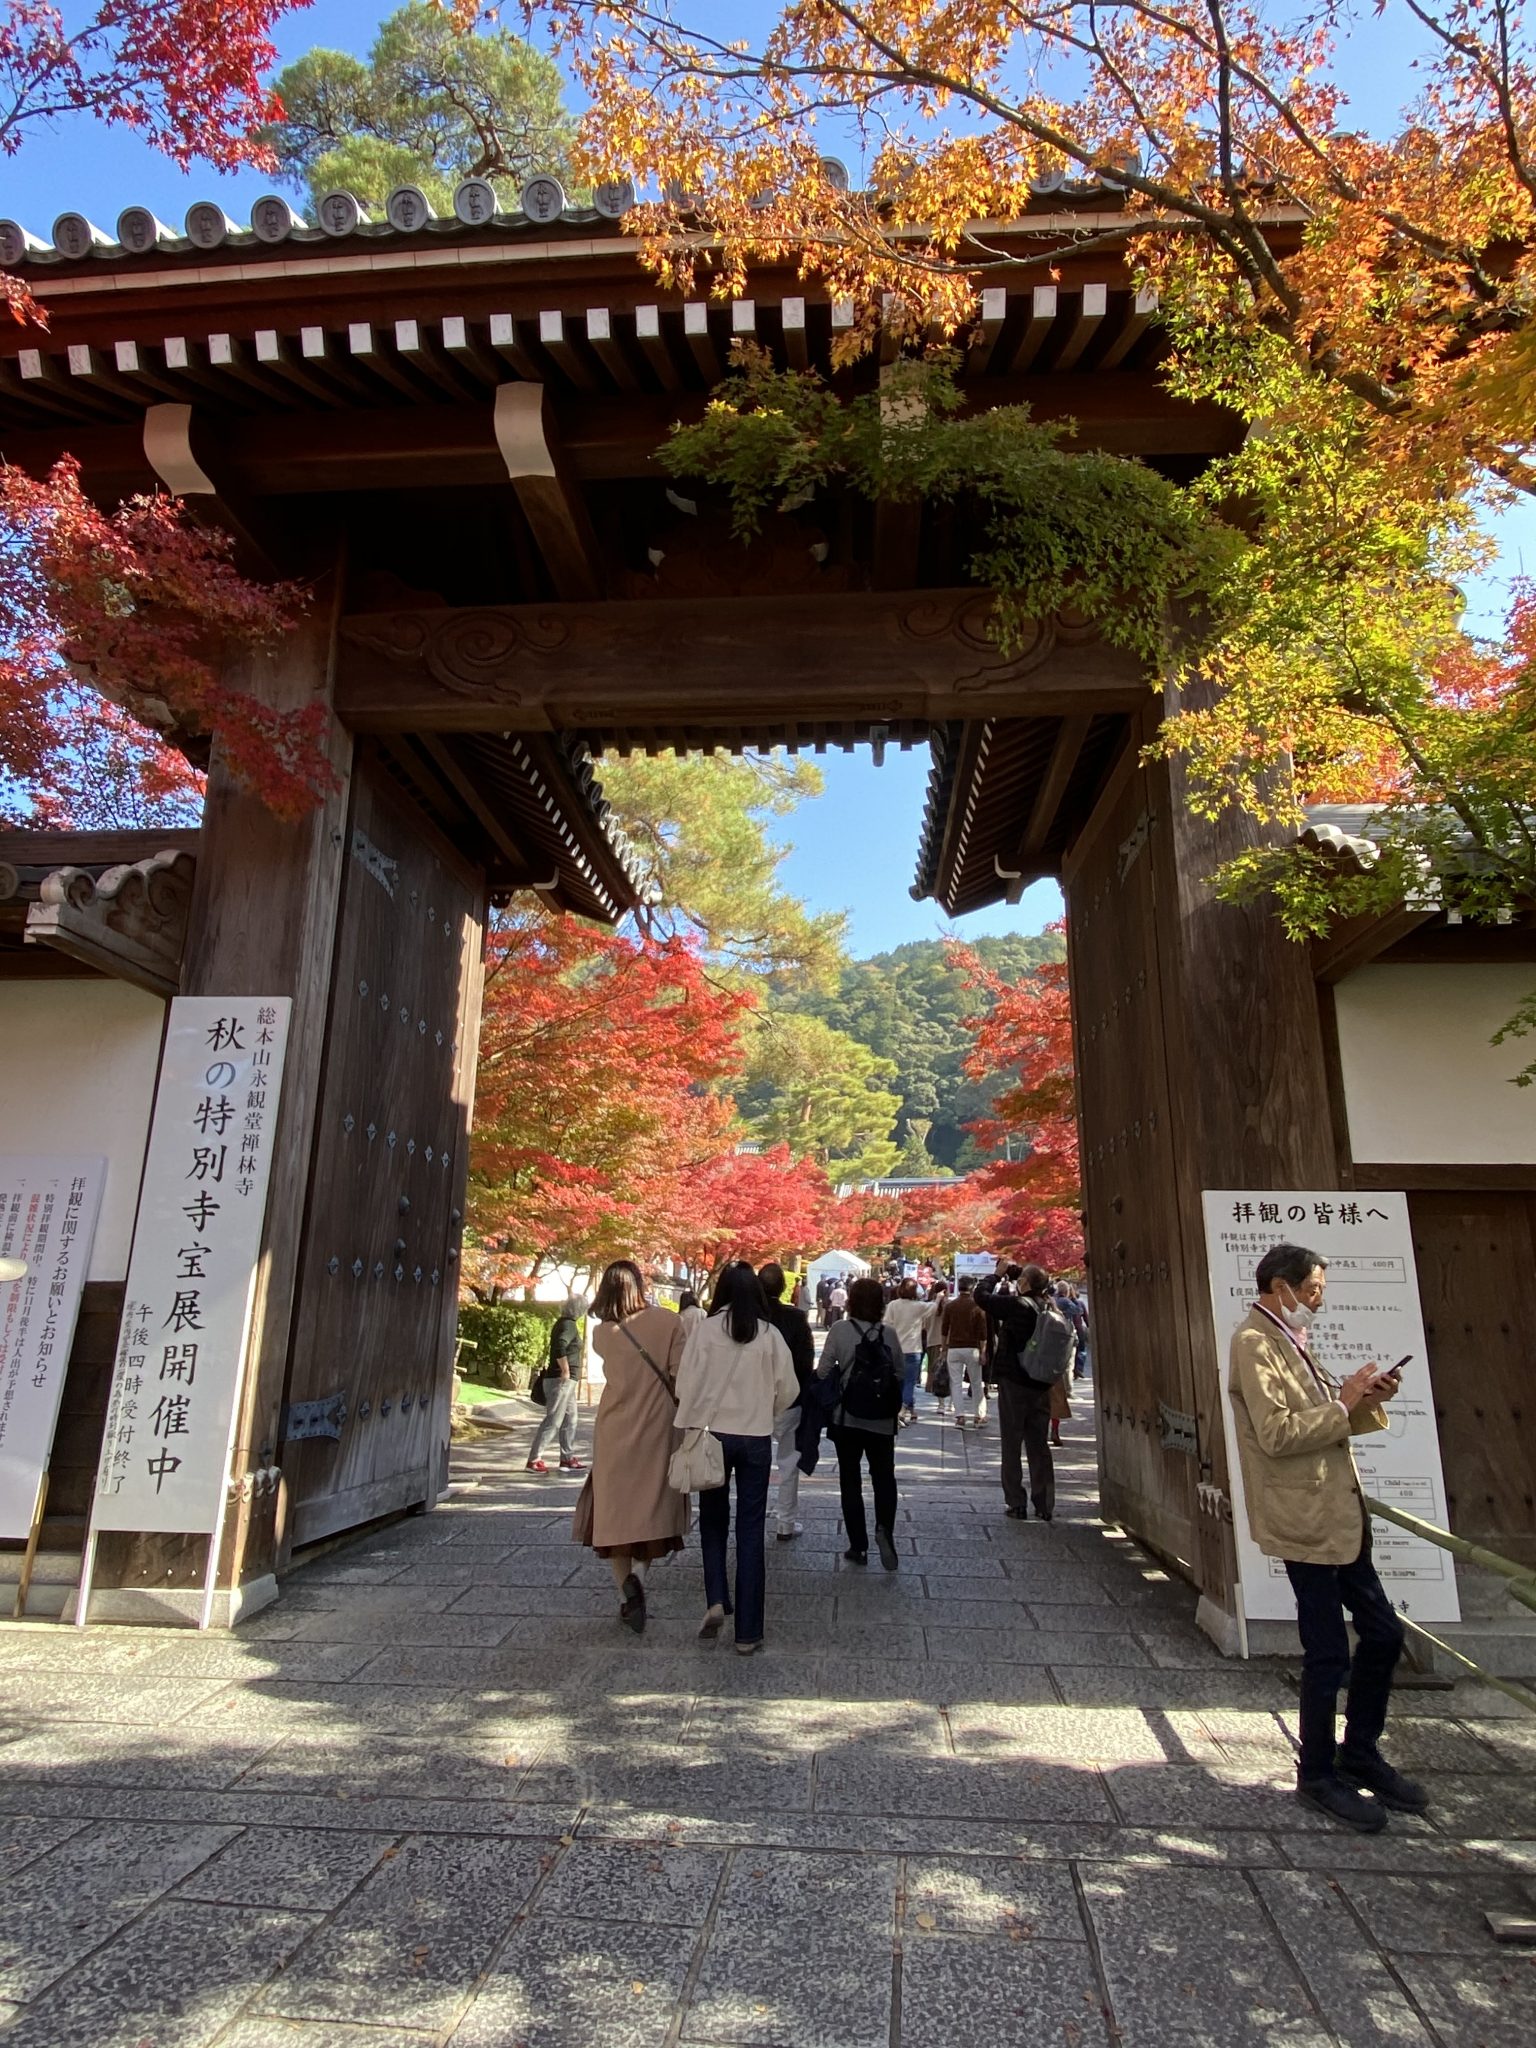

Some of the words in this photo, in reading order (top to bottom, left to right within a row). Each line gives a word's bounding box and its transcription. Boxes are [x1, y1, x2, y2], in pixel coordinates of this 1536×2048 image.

[234, 1007, 276, 1197] 総本山永観堂禅林寺
[31, 1176, 87, 1388] 拝観に関するお願いとお知らせ
[147, 1016, 246, 1496] 秋の特別寺宝展開催中
[1232, 1201, 1390, 1226] 拝観の皆様へ
[112, 1303, 154, 1494] 午後四時受付終了
